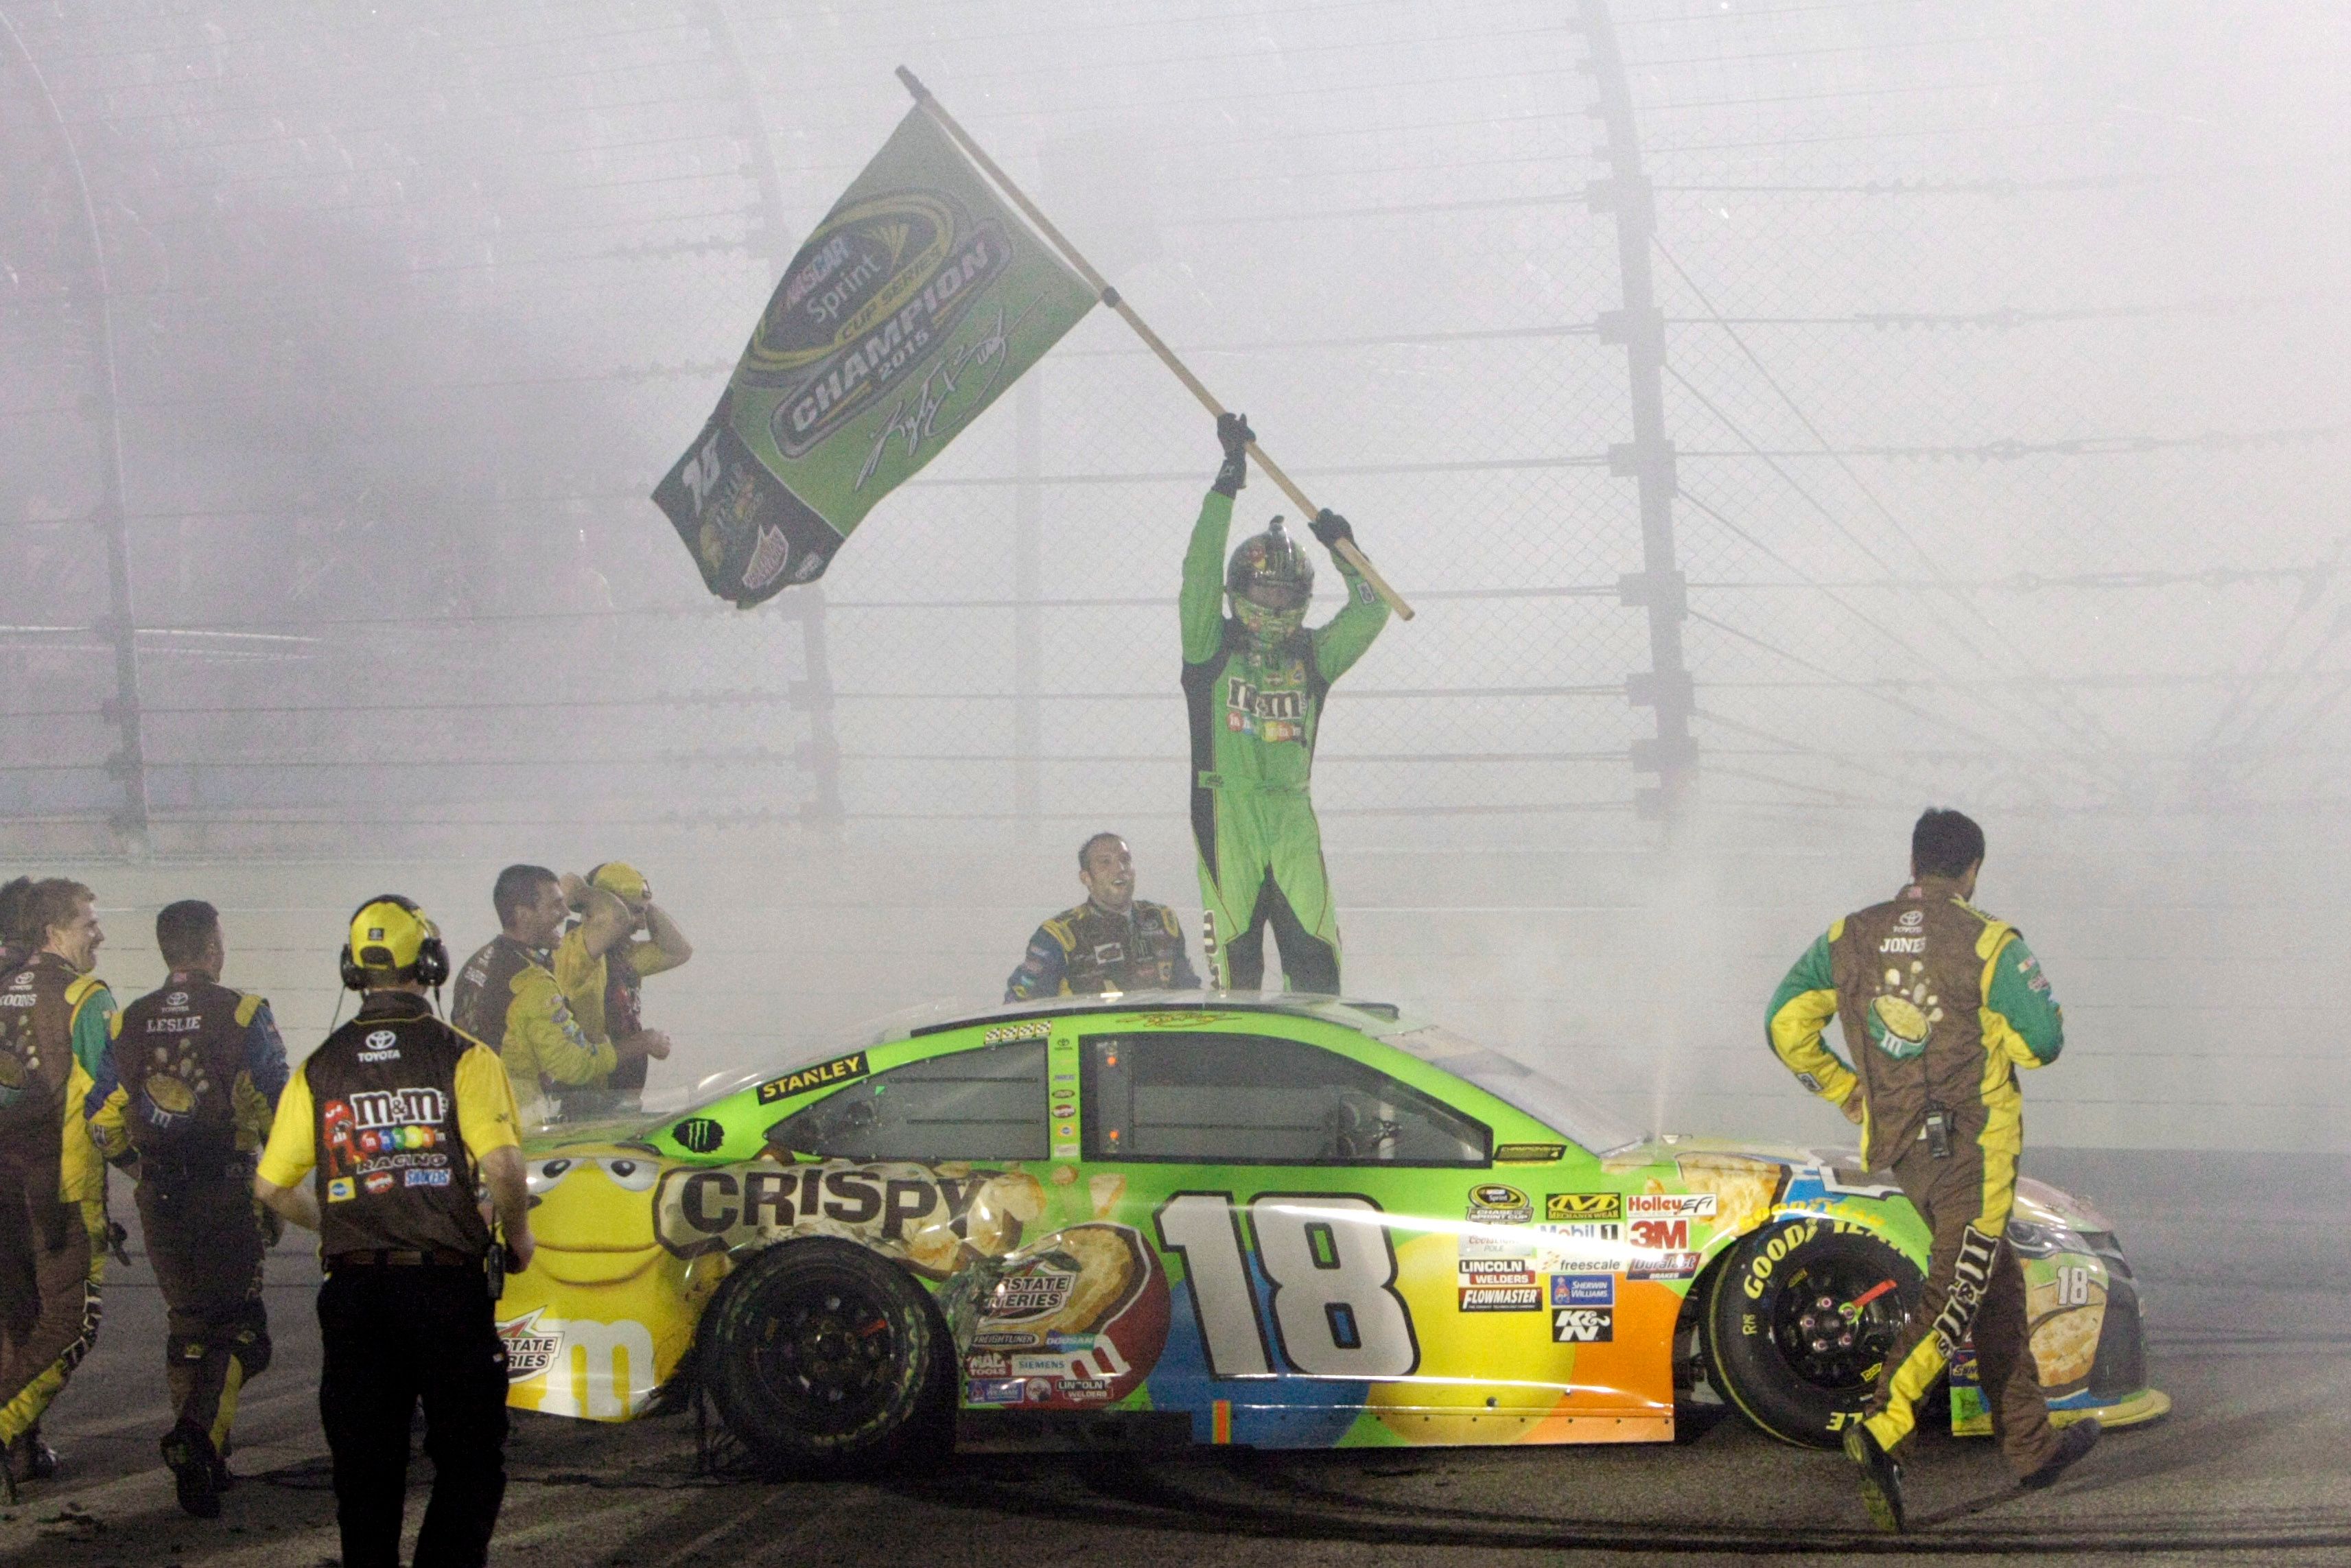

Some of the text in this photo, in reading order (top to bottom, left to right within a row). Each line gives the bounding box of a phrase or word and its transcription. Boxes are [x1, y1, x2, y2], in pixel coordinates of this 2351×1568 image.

[807, 255, 881, 324] Sprint
[793, 241, 989, 432] CHAMPION
[878, 328, 930, 382] 2015
[146, 1016, 202, 1033] LESLIE
[358, 1050, 401, 1062] TOYOTA
[762, 1056, 860, 1098] STANLEY
[356, 1154, 447, 1174] RACING
[681, 1168, 987, 1239] CRISPY
[1628, 1197, 1682, 1215] Holley
[1630, 1220, 1687, 1250] 3M
[1462, 1261, 1523, 1272] LINCOLN
[1560, 1259, 1621, 1270] freescale
[1154, 1190, 1420, 1382] 18
[1475, 1274, 1529, 1284] WELDERS
[1572, 1280, 1607, 1289] SHERWIN
[2057, 1266, 2087, 1304] 18
[1463, 1289, 1537, 1309] FLOWMASTER
[1571, 1288, 1608, 1298] WILLIAMS
[970, 1368, 1007, 1376] TOOLS
[1019, 1360, 1065, 1369] SIEMENS
[1068, 1390, 1108, 1399] WELDERS
